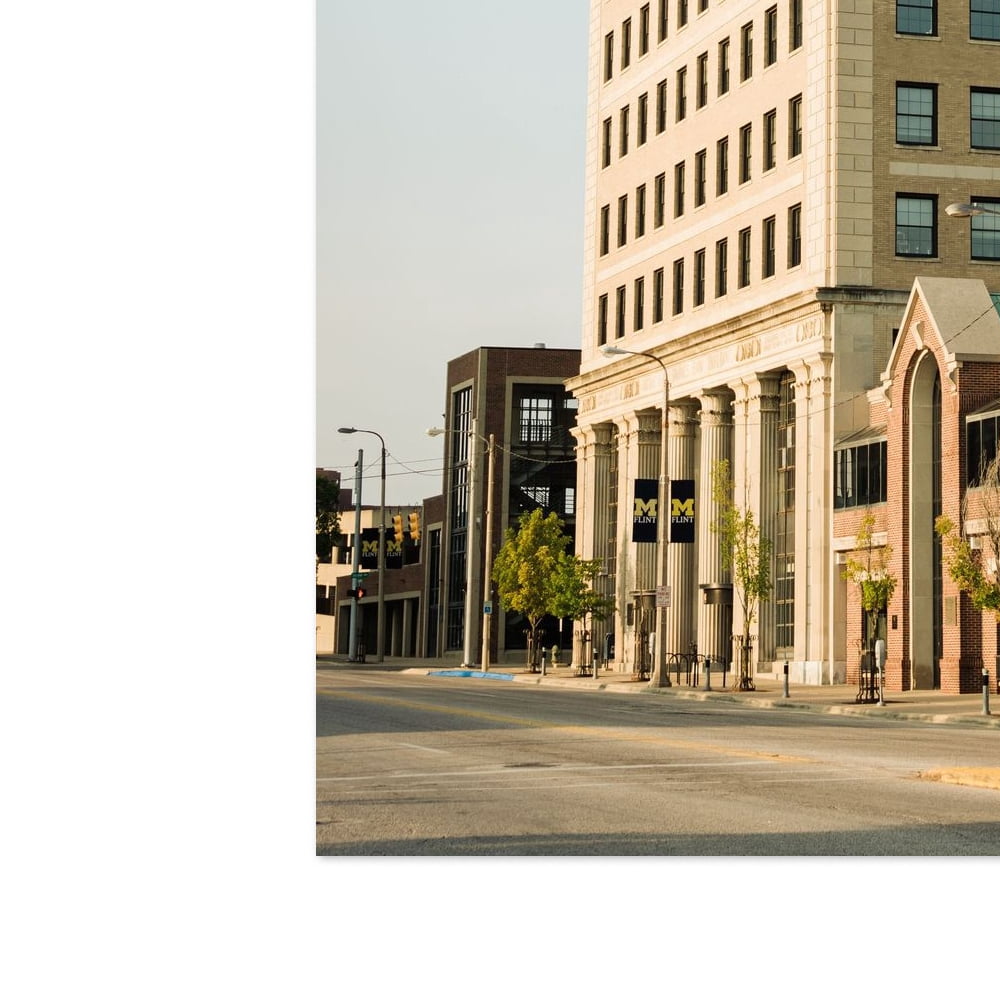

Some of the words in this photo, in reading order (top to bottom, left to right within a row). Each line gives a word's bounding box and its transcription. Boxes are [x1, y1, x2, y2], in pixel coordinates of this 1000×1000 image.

[634, 498, 658, 516] M
[671, 498, 694, 516] M
[633, 516, 656, 524] FLINT
[671, 516, 694, 524] FLINT
[362, 540, 378, 552] M
